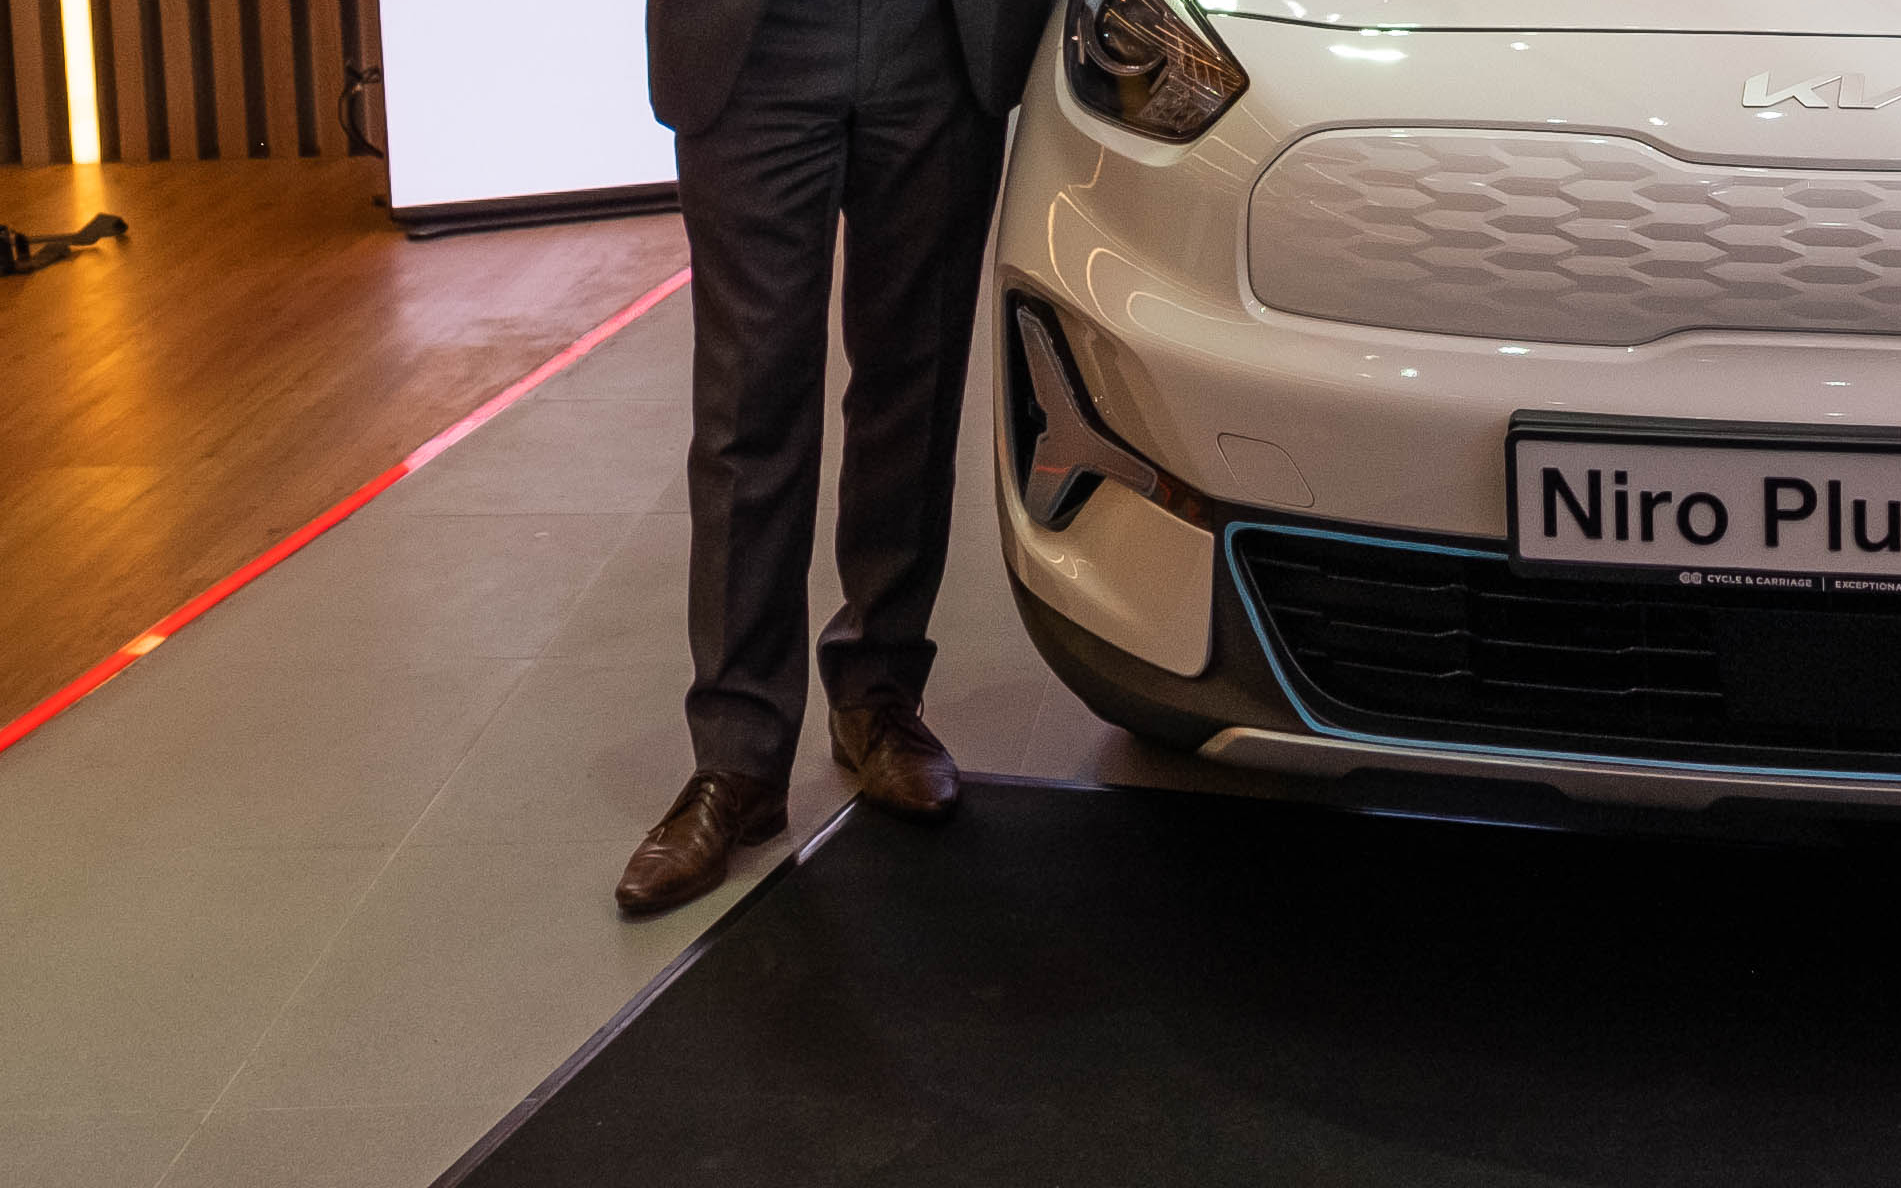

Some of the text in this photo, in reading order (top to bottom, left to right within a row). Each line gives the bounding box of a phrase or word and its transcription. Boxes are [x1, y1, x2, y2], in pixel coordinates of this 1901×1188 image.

[1541, 467, 1729, 546] Niro
[1706, 573, 1743, 585] CYCLE
[1756, 576, 1813, 588] CARRIAGE
